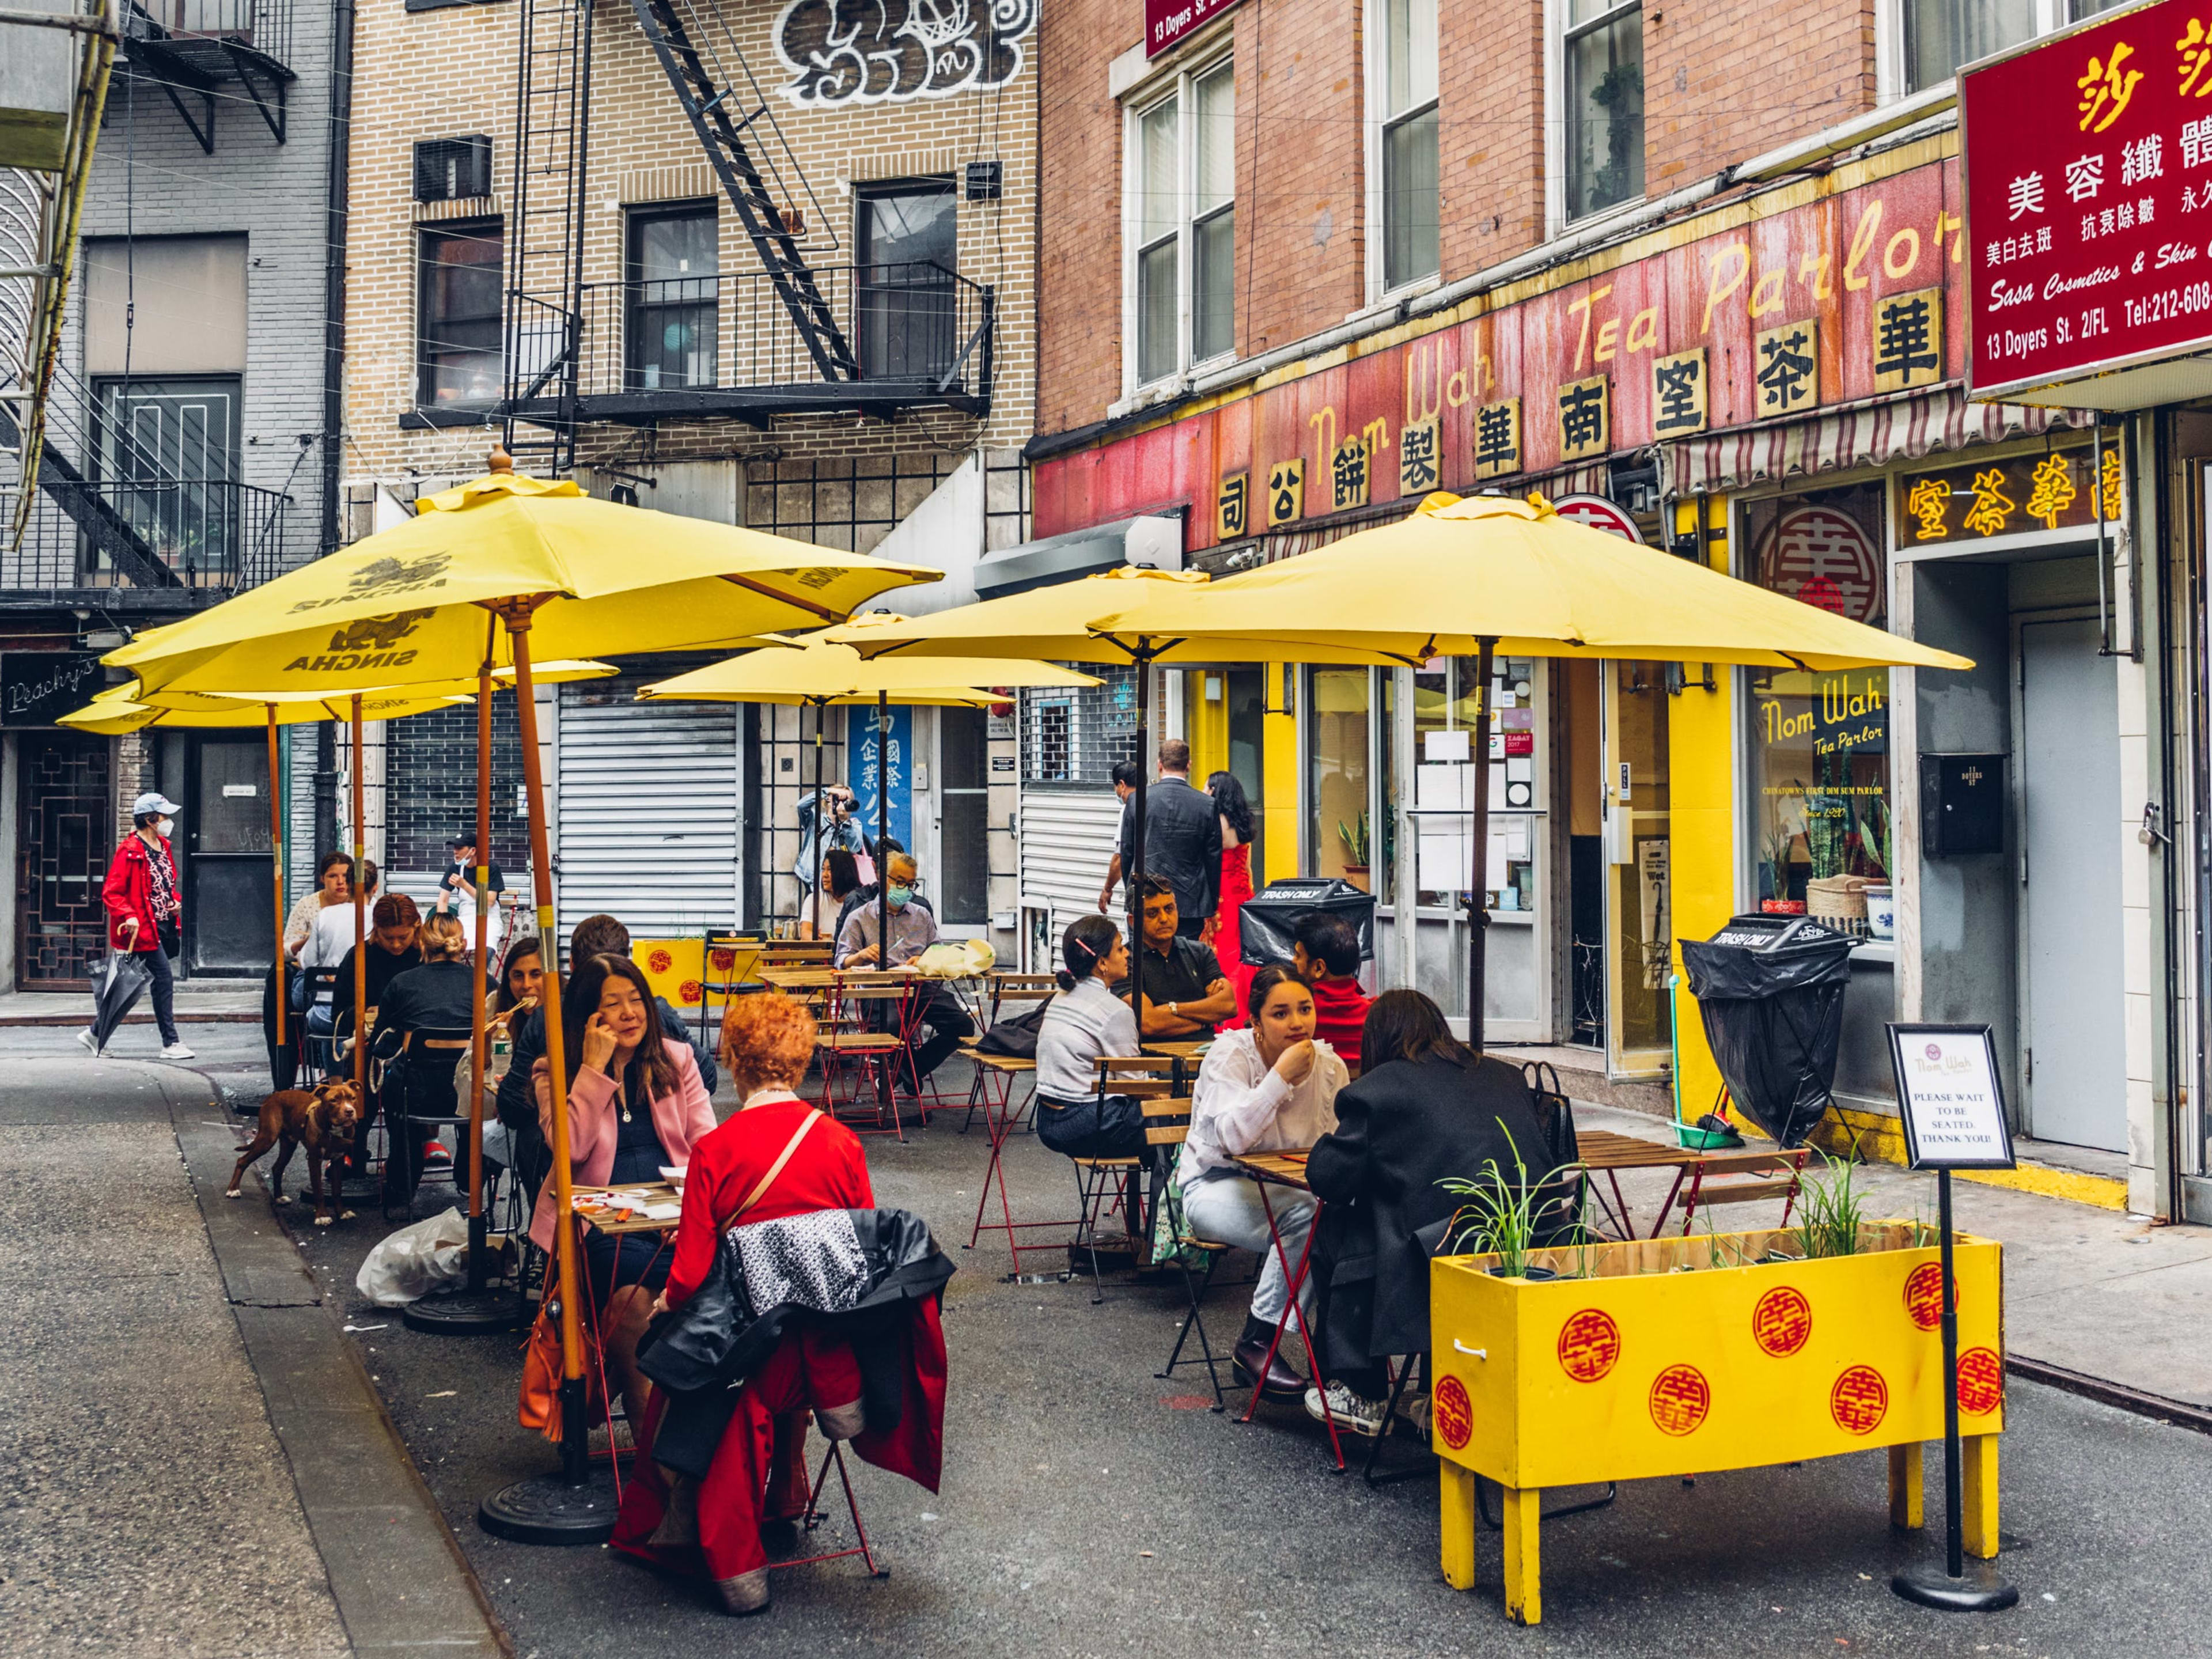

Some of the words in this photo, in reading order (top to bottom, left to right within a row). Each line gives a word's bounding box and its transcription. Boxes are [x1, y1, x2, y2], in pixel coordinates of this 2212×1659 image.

[1155, 21, 1164, 43] 13
[1166, 7, 1191, 36] Doyers
[1986, 227, 2052, 267] 美白去斑
[2081, 195, 2154, 241] 抗衰除皺
[1988, 279, 2034, 312] Sasa
[2044, 265, 2120, 300] Cosmetics
[2131, 251, 2144, 274] &
[2154, 241, 2197, 269] Skin
[1407, 328, 1495, 422] Wah
[1567, 283, 1658, 372] Tea
[1700, 200, 1961, 334] Parlor
[1987, 334, 1999, 360] 13
[2006, 325, 2047, 359] Doyers
[2056, 317, 2073, 344] St.
[2082, 308, 2109, 338] 2/FL
[286, 578, 447, 615] SINGHA
[1762, 700, 1816, 743] Nom
[1824, 675, 1882, 724] Wah
[1815, 738, 1834, 755] Tea
[1838, 726, 1882, 748] Parlor
[1763, 787, 1804, 795] CHINATOWN'S
[1806, 787, 1824, 795] FIRST
[1827, 787, 1839, 795] DIM
[1841, 787, 1854, 795] SUM
[1857, 787, 1883, 795] PARLOR
[1823, 807, 1846, 817] 1920
[1262, 891, 1293, 899] TRASH
[1294, 891, 1320, 899] ONLY
[1714, 933, 1746, 945] TRASH
[1744, 934, 1775, 946] ONLY
[1922, 1134, 1961, 1143] THANK
[1965, 1134, 1991, 1143] YOU!
[1931, 1121, 1975, 1129] SEATED.
